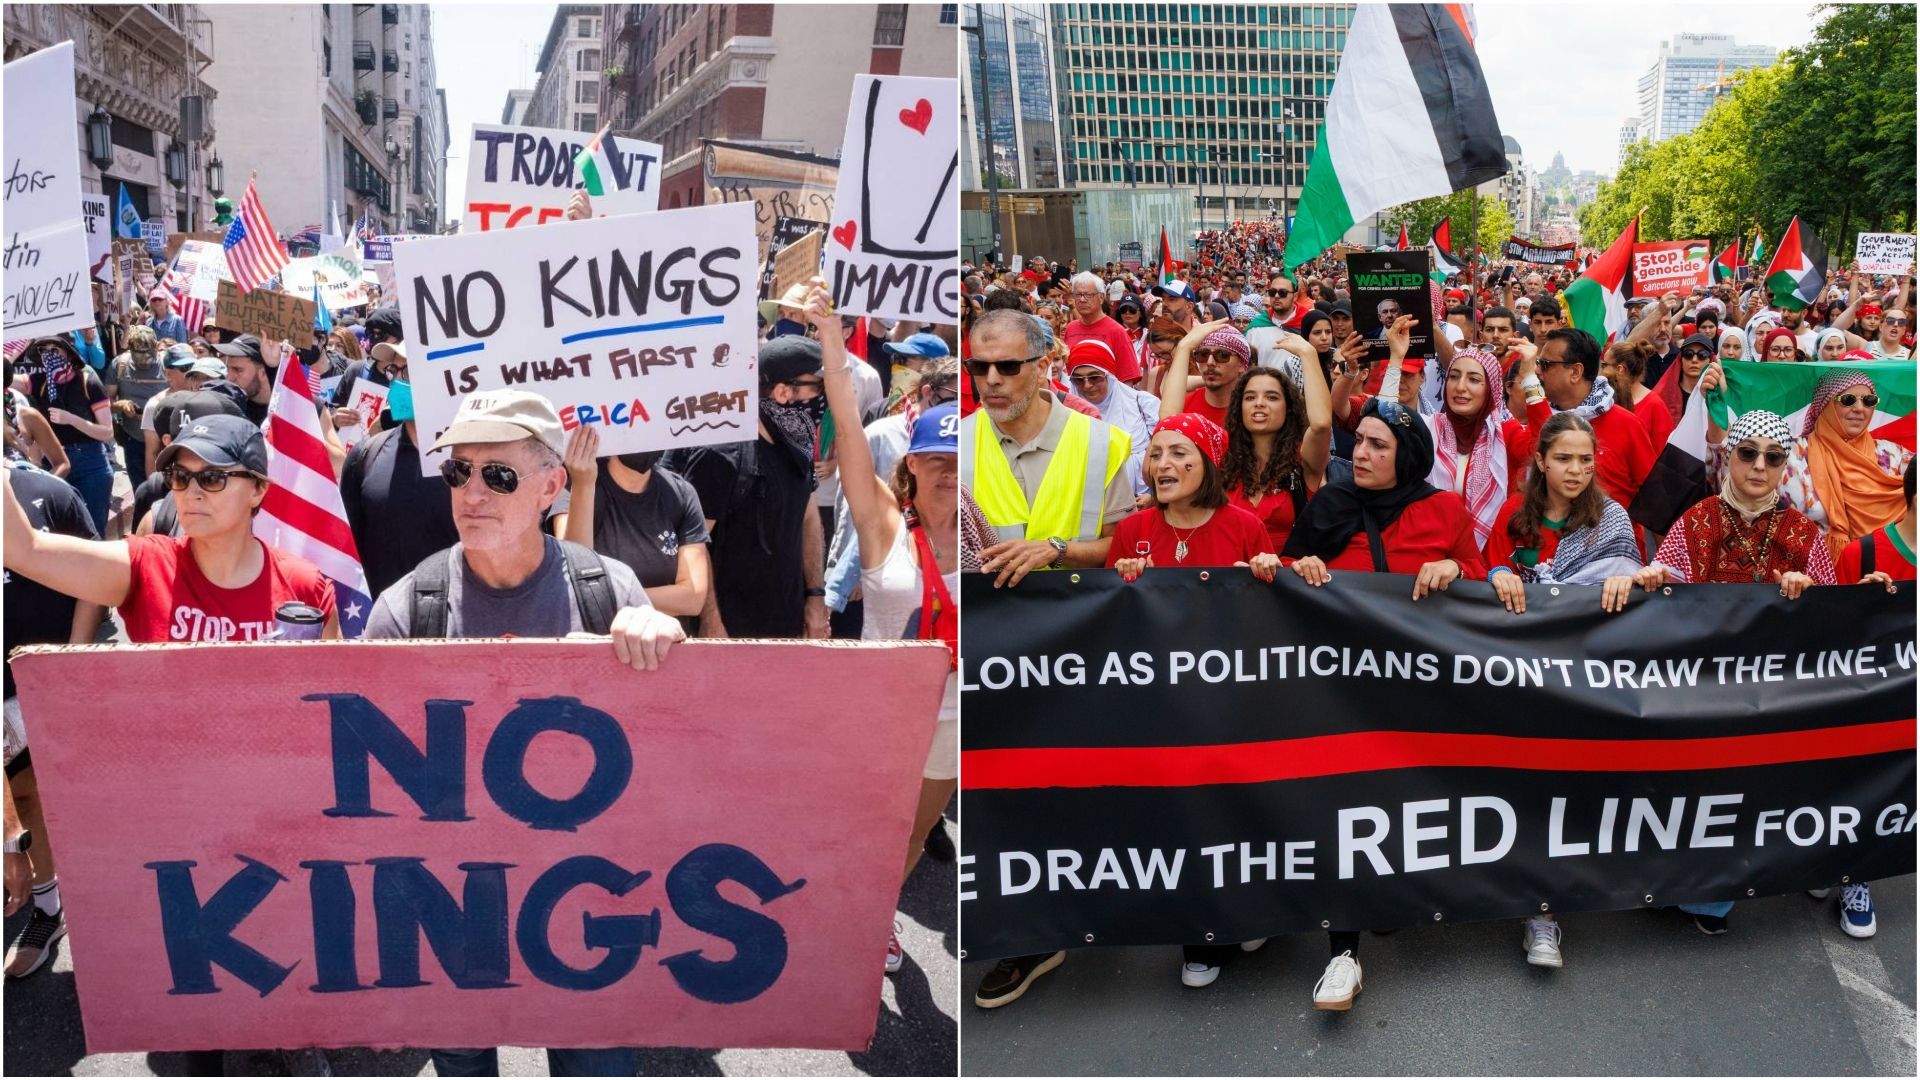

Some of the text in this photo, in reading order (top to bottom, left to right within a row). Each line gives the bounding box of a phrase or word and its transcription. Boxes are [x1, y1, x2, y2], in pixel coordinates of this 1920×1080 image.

[475, 129, 588, 188] TROOP
[791, 225, 808, 234] was
[1508, 242, 1574, 263] STOP ARMING ISRAEL
[1640, 252, 1677, 267] Stop
[1859, 243, 1881, 251] THAT
[1354, 273, 1424, 286] WANTED
[1639, 261, 1700, 279] genocide
[1642, 276, 1698, 292] sanctions NOW
[328, 282, 349, 290] THIS
[413, 271, 506, 346] NO
[538, 246, 741, 328] KINGS
[292, 301, 305, 317] A
[444, 365, 479, 396] IS
[500, 353, 593, 386] WHAT
[608, 345, 697, 380] FIRST
[559, 390, 749, 432] ERICA GREAT
[170, 605, 237, 641] STOP
[961, 652, 1086, 692] LONG
[1099, 651, 1156, 686] AS
[1169, 645, 1440, 685] POLITICIANS
[1452, 654, 1573, 688] DON'T
[1584, 657, 1704, 690] DRAW
[1712, 653, 1787, 686] THE
[1795, 645, 1888, 681] LINE,
[301, 693, 634, 833] NO
[1000, 847, 1187, 896] DRAW
[1200, 840, 1317, 888] THE
[1338, 794, 1517, 880] RED
[1548, 793, 1745, 858] LINE
[1754, 805, 1862, 847] FOR
[142, 841, 807, 1005] KINGS
